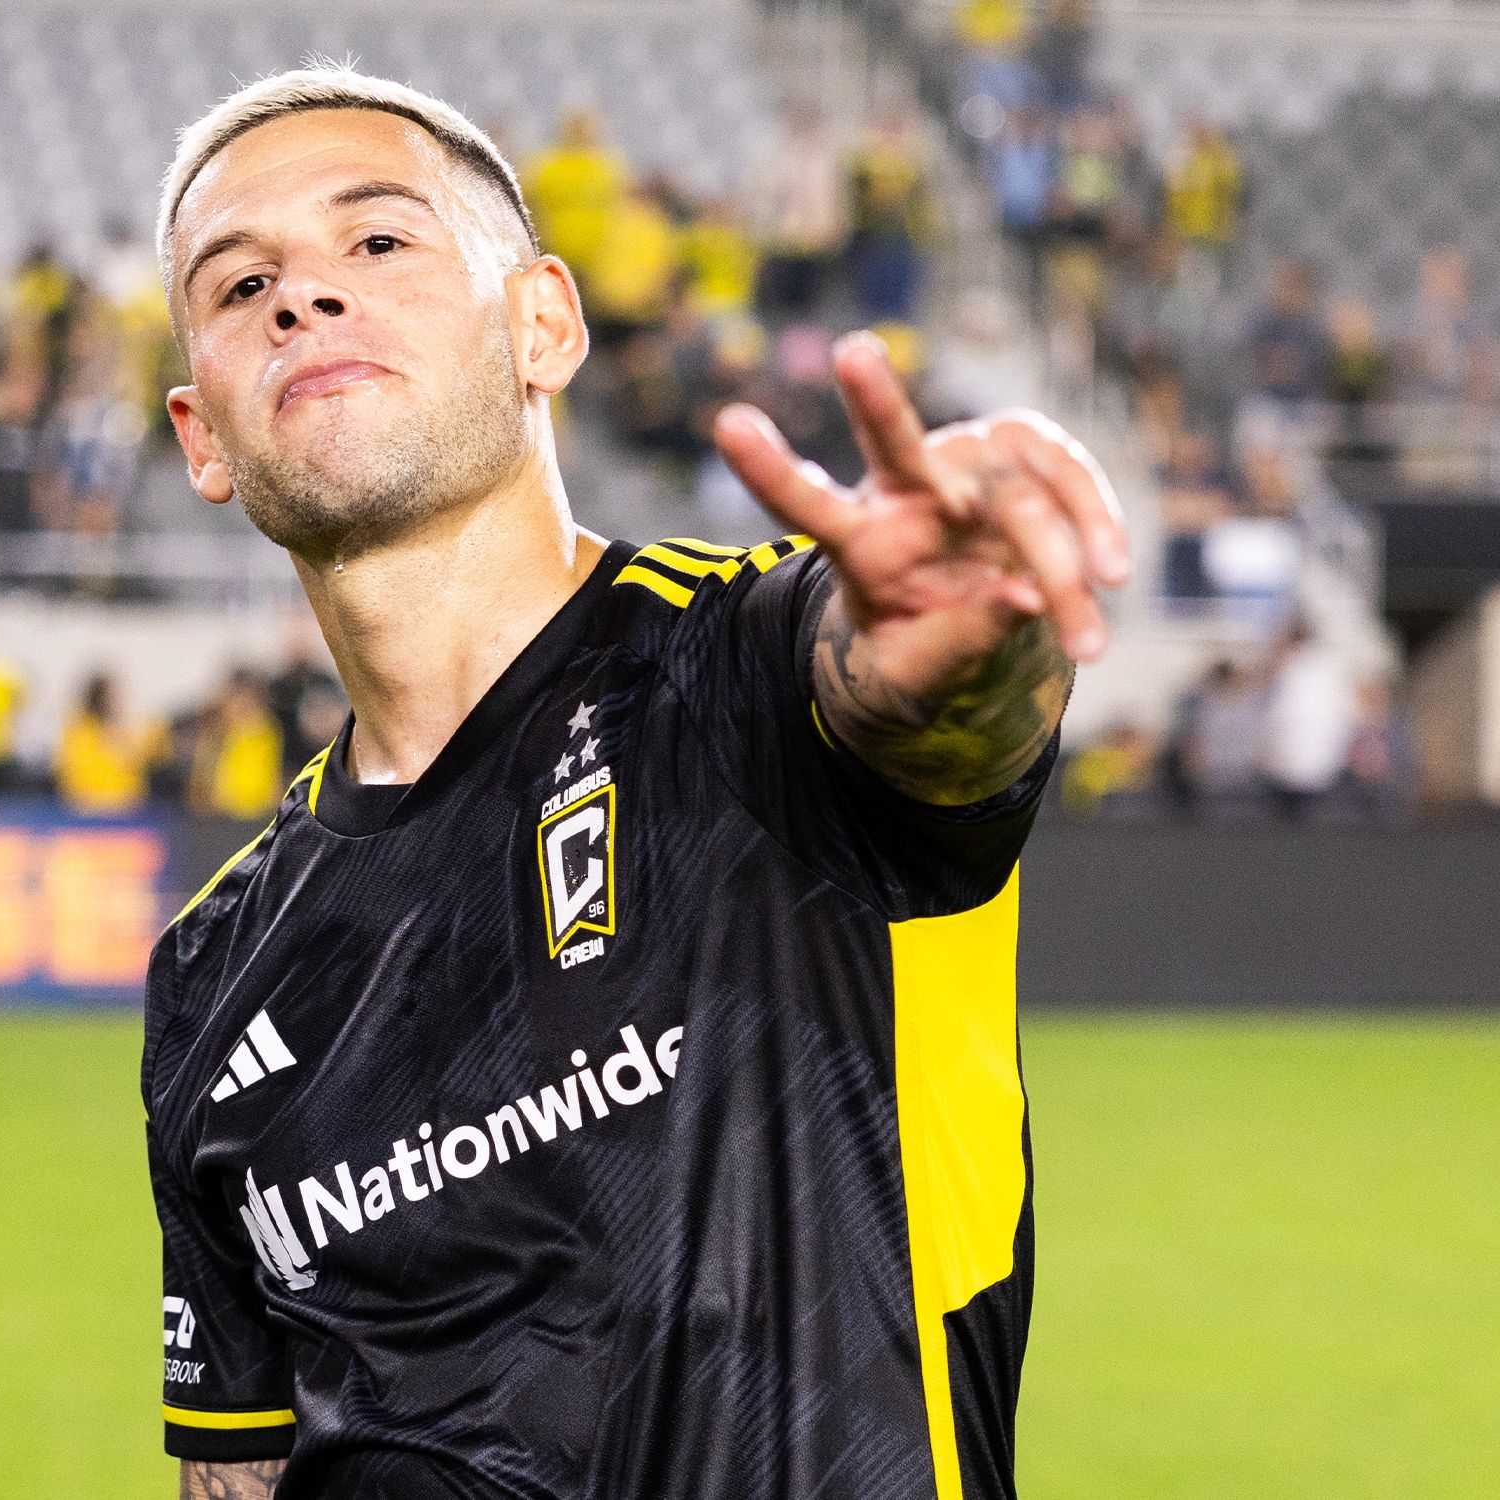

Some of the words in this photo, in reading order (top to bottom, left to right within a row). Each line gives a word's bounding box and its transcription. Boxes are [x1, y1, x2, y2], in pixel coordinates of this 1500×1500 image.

[541, 766, 611, 820] COLUMBUS
[546, 806, 605, 938] C
[588, 900, 606, 919] 96
[560, 937, 605, 970] CREW
[298, 1024, 684, 1249] Nationwide
